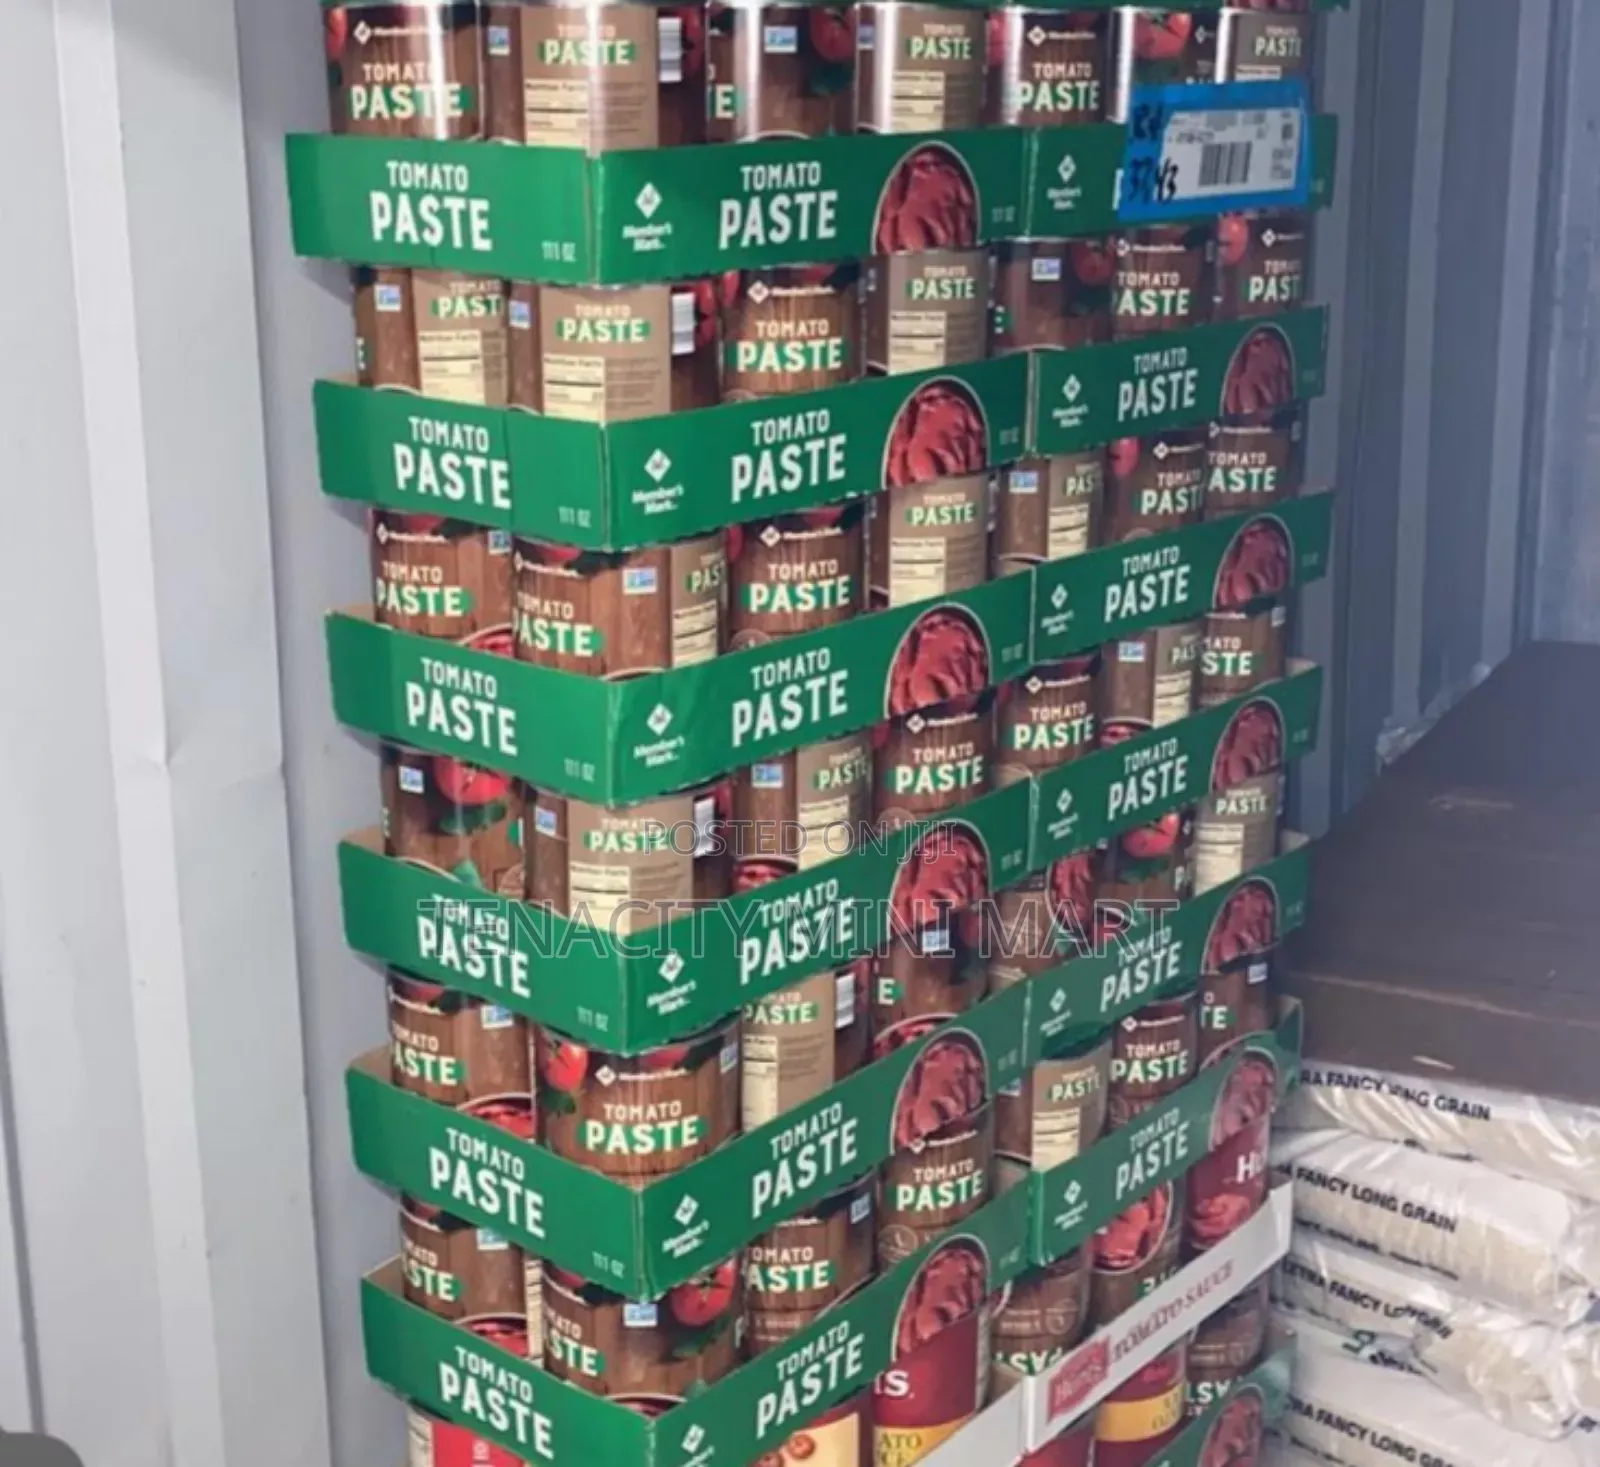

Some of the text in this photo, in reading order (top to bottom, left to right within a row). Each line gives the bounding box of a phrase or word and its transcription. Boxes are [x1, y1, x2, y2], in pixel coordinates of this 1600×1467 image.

[544, 40, 630, 66] PASTE
[911, 37, 972, 60] PASTE
[363, 62, 440, 82] TOMAT
[1033, 62, 1092, 79] TOMATO
[351, 84, 462, 120] PASTE
[1016, 80, 1099, 112] PASTE
[386, 160, 469, 192] TOMATO
[740, 161, 822, 192] TOMATO
[370, 191, 492, 251] PASTE
[719, 190, 838, 251] PASTE
[911, 278, 974, 300] PASTE
[1117, 272, 1180, 286] TOMATO
[1249, 275, 1300, 302] PAST
[438, 296, 499, 318] PAST
[574, 304, 631, 318] TOMATO
[1114, 288, 1190, 316] ASTE
[561, 319, 646, 343] PASTE
[755, 319, 829, 339] TOMATO
[736, 338, 842, 372] PASTE
[1133, 348, 1188, 375] TOMATO
[1118, 368, 1198, 422] PASTE
[408, 416, 490, 452] TOMATO
[751, 408, 830, 447] TOMATO
[393, 443, 512, 509] PASTE
[731, 434, 847, 502] PASTE
[1208, 452, 1267, 466] TOMATO
[1066, 475, 1094, 497] PAS
[1208, 467, 1277, 493] ASTE
[911, 504, 974, 526] PASTE
[382, 561, 443, 583] TOMATO
[768, 559, 839, 580] TOMATO
[1122, 546, 1180, 577] TOMATO
[376, 577, 464, 617] PASTE
[749, 575, 850, 613] PASTE
[1104, 565, 1190, 622] PASTE
[1202, 636, 1241, 651] ATO
[420, 657, 498, 701] TOMATO
[751, 647, 831, 691] TOMATO
[1201, 651, 1253, 676] STE
[405, 681, 518, 756] PASTE
[731, 669, 848, 748] PASTE
[1029, 701, 1088, 721] TOMATO
[1013, 715, 1094, 750] PASTE
[913, 742, 974, 763] TOMATO
[1123, 738, 1178, 774] TOMATO
[895, 755, 984, 795] PASTE
[1108, 755, 1188, 821] PASTE
[1216, 794, 1267, 816] PASTE
[589, 831, 670, 852] PASTE
[431, 893, 509, 941] TOMATO
[760, 878, 839, 928] TOMATO
[417, 915, 531, 999] PASTE
[740, 898, 855, 986] PASTE
[1118, 926, 1172, 968] TOMATO
[1100, 940, 1182, 1013] PASTE
[395, 1041, 457, 1085] ASTE
[1125, 1039, 1181, 1060] TOMATO
[1110, 1052, 1188, 1085] PASTE
[603, 1100, 682, 1123] TOMATO
[1326, 1071, 1384, 1093] FANCY
[1434, 1095, 1491, 1121] GRAIN
[585, 1115, 699, 1155] PASTE
[770, 1101, 842, 1161] TOMATO
[1129, 1108, 1180, 1145] TOMATO
[446, 1127, 526, 1181] TOMATO
[752, 1117, 858, 1220] PASTE
[913, 1158, 975, 1183] TOMATO
[1115, 1121, 1190, 1201] PASTE
[429, 1146, 546, 1240] PASTE
[896, 1169, 985, 1212] PASTE
[1295, 1167, 1350, 1197] FANCY
[1351, 1184, 1399, 1213] LONG
[1402, 1202, 1457, 1233] GRAIN
[751, 1246, 814, 1262] OMATO
[403, 1252, 455, 1302] STE
[746, 1260, 831, 1293] ASTE
[1329, 1280, 1383, 1312] FANCY
[544, 1327, 600, 1377] STE
[776, 1320, 850, 1382] TOMATO
[454, 1345, 534, 1404] TOMATO
[756, 1332, 865, 1440] PASTE
[439, 1361, 554, 1460] PASTE
[880, 1432, 922, 1449] ATO
[1316, 1408, 1368, 1441] FANCY
[1370, 1431, 1416, 1463] LONG
